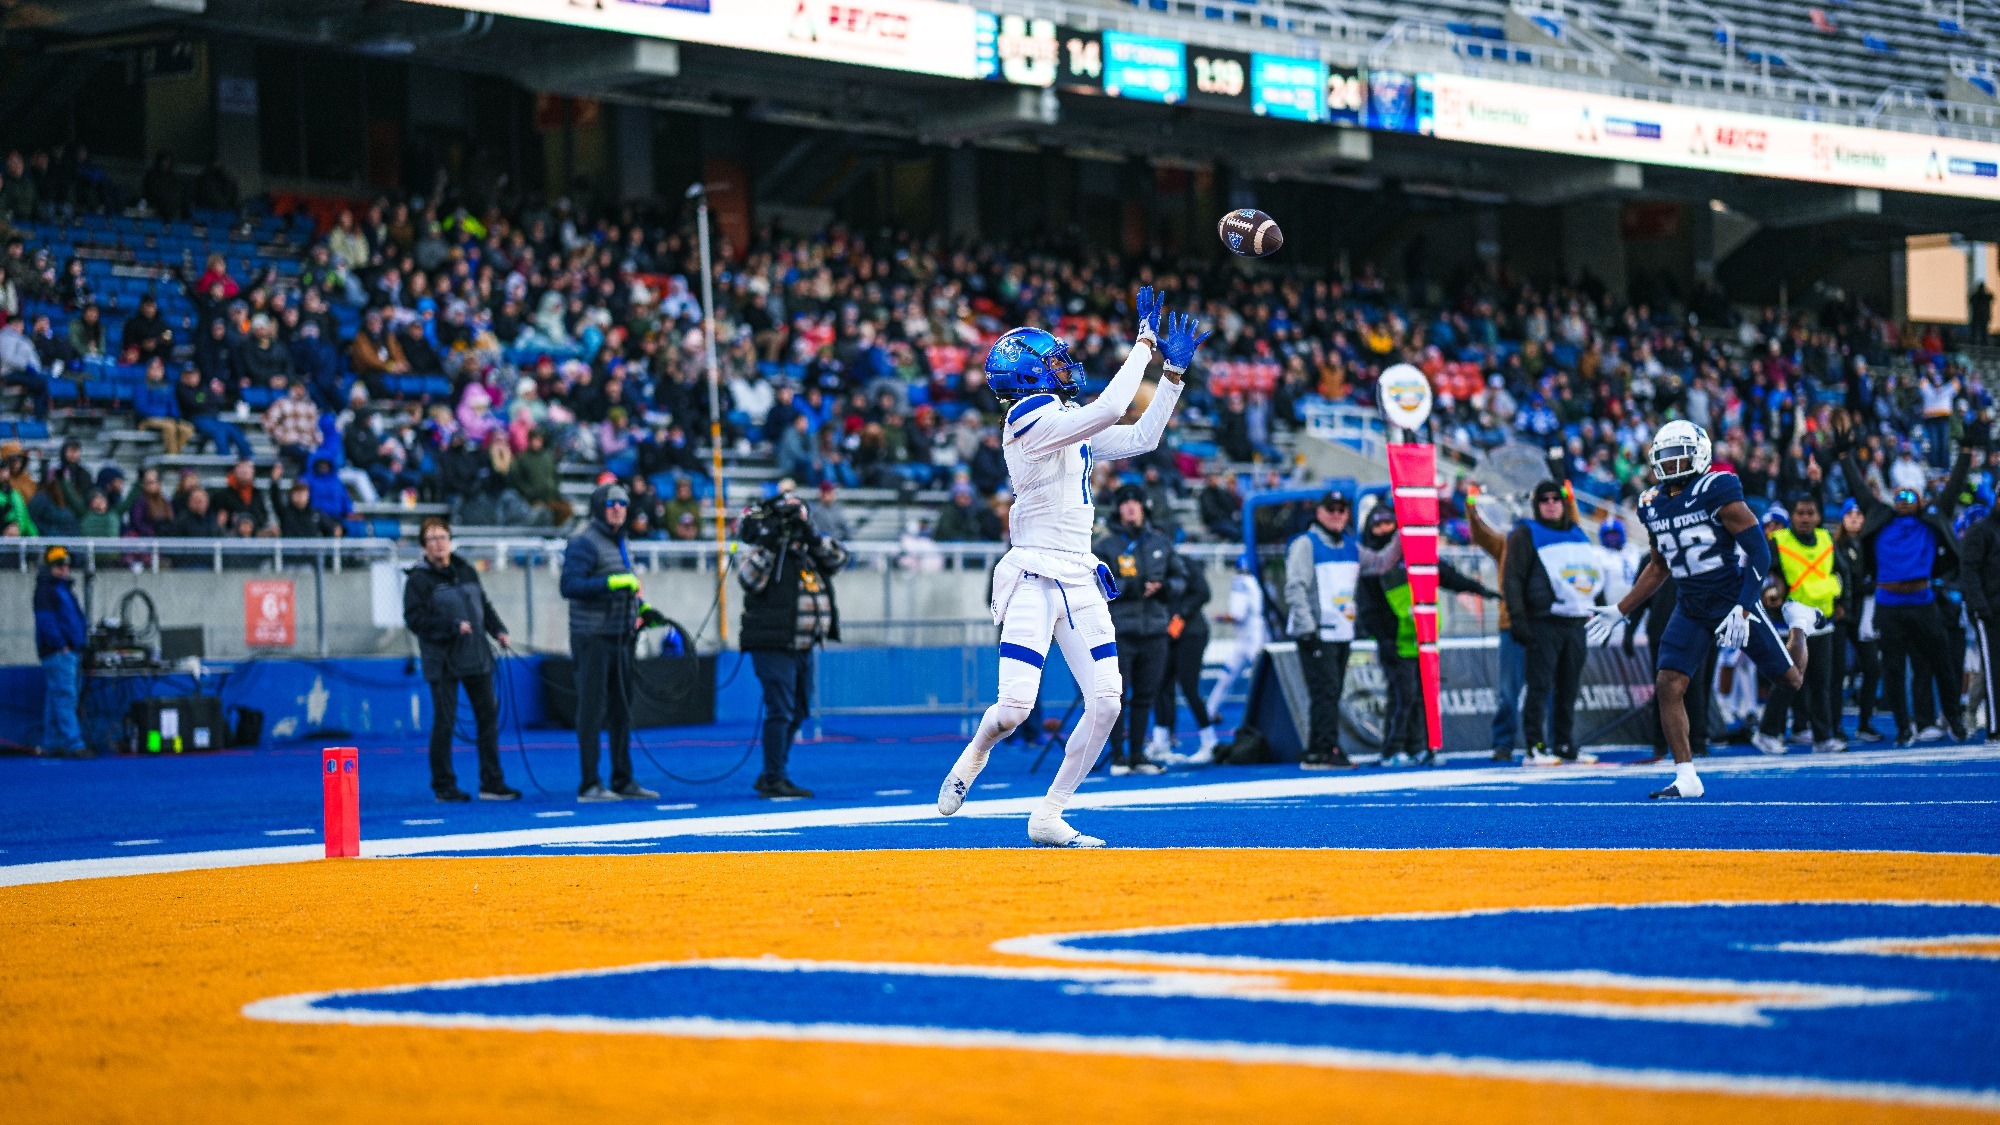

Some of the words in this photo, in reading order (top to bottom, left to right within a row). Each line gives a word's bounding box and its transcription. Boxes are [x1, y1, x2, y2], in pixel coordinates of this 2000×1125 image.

[1065, 37, 1101, 78] 14
[1672, 509, 1709, 529] STATE
[1656, 523, 1725, 579] 22
